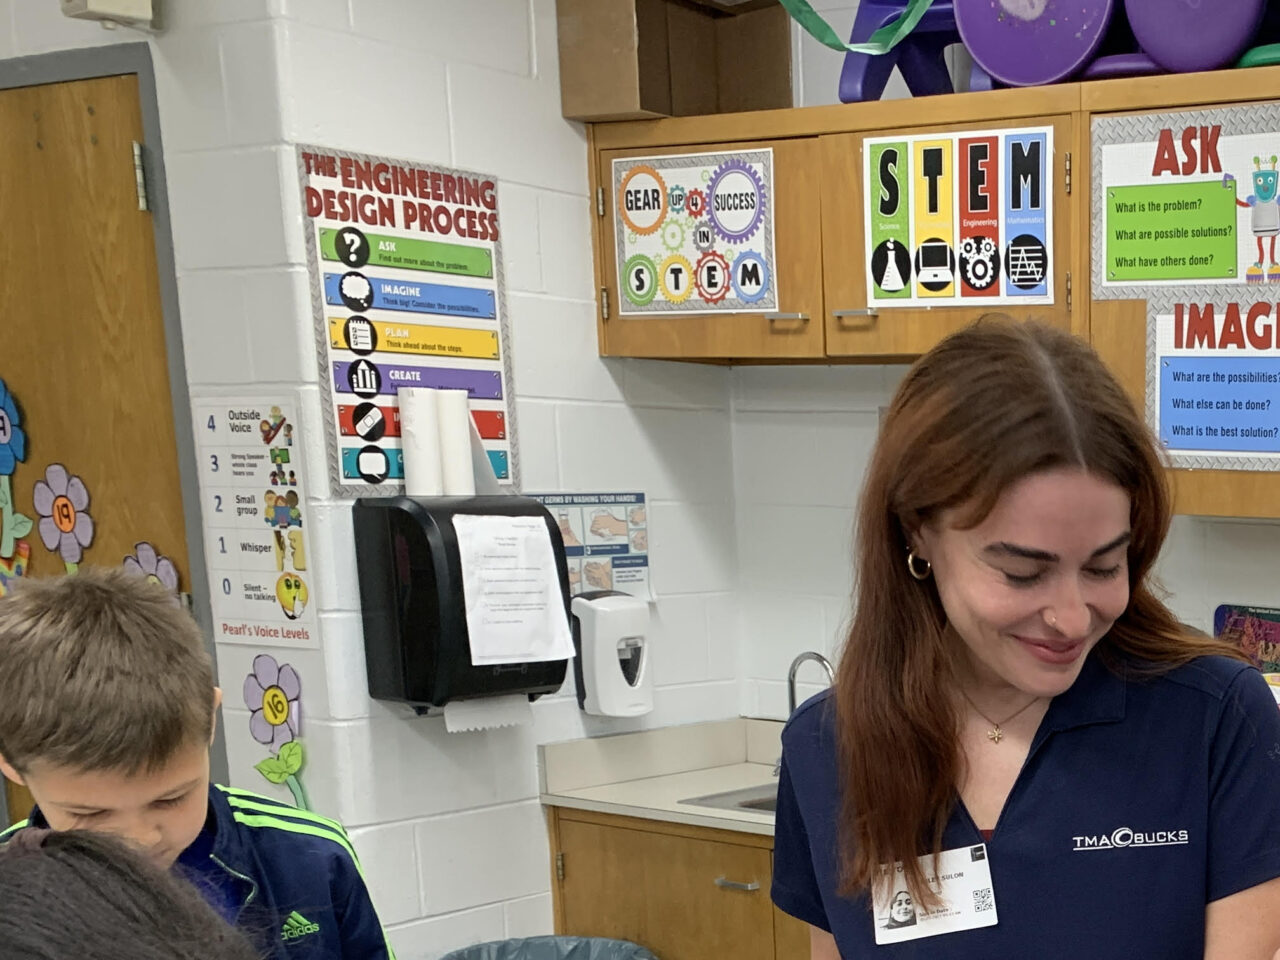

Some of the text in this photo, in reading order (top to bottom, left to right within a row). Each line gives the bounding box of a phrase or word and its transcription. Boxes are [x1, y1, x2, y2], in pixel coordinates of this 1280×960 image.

[1152, 125, 1222, 177] ASK
[302, 152, 496, 210] THE ENGINEERING
[625, 189, 756, 211] GEAR UP 4 SUCCESS
[1115, 199, 1202, 213] What is the problem?
[305, 186, 499, 242] DESIGN PROCESS
[963, 219, 998, 228] Engineering
[699, 230, 709, 243] IN
[1115, 225, 1232, 241] What are possible solutions?
[379, 241, 397, 252] ASK
[381, 284, 421, 297] IMAGINE
[385, 328, 409, 338] PLAN
[389, 370, 421, 381] CREATE
[1172, 372, 1195, 382] What
[1197, 373, 1211, 383] are
[1213, 372, 1225, 383] the
[228, 410, 261, 420] Outside
[208, 415, 216, 432] 4
[229, 423, 252, 432] Voice
[1172, 425, 1279, 438] What is the best solution?
[210, 454, 219, 472] 3
[214, 495, 223, 512] 2
[236, 495, 256, 504] Small
[237, 506, 258, 516] group
[218, 536, 227, 553] 1
[240, 542, 272, 554] Whisper
[222, 623, 309, 640] Pearl's Voice Levels
[941, 872, 964, 880] SULON
[281, 923, 320, 941] adidas
